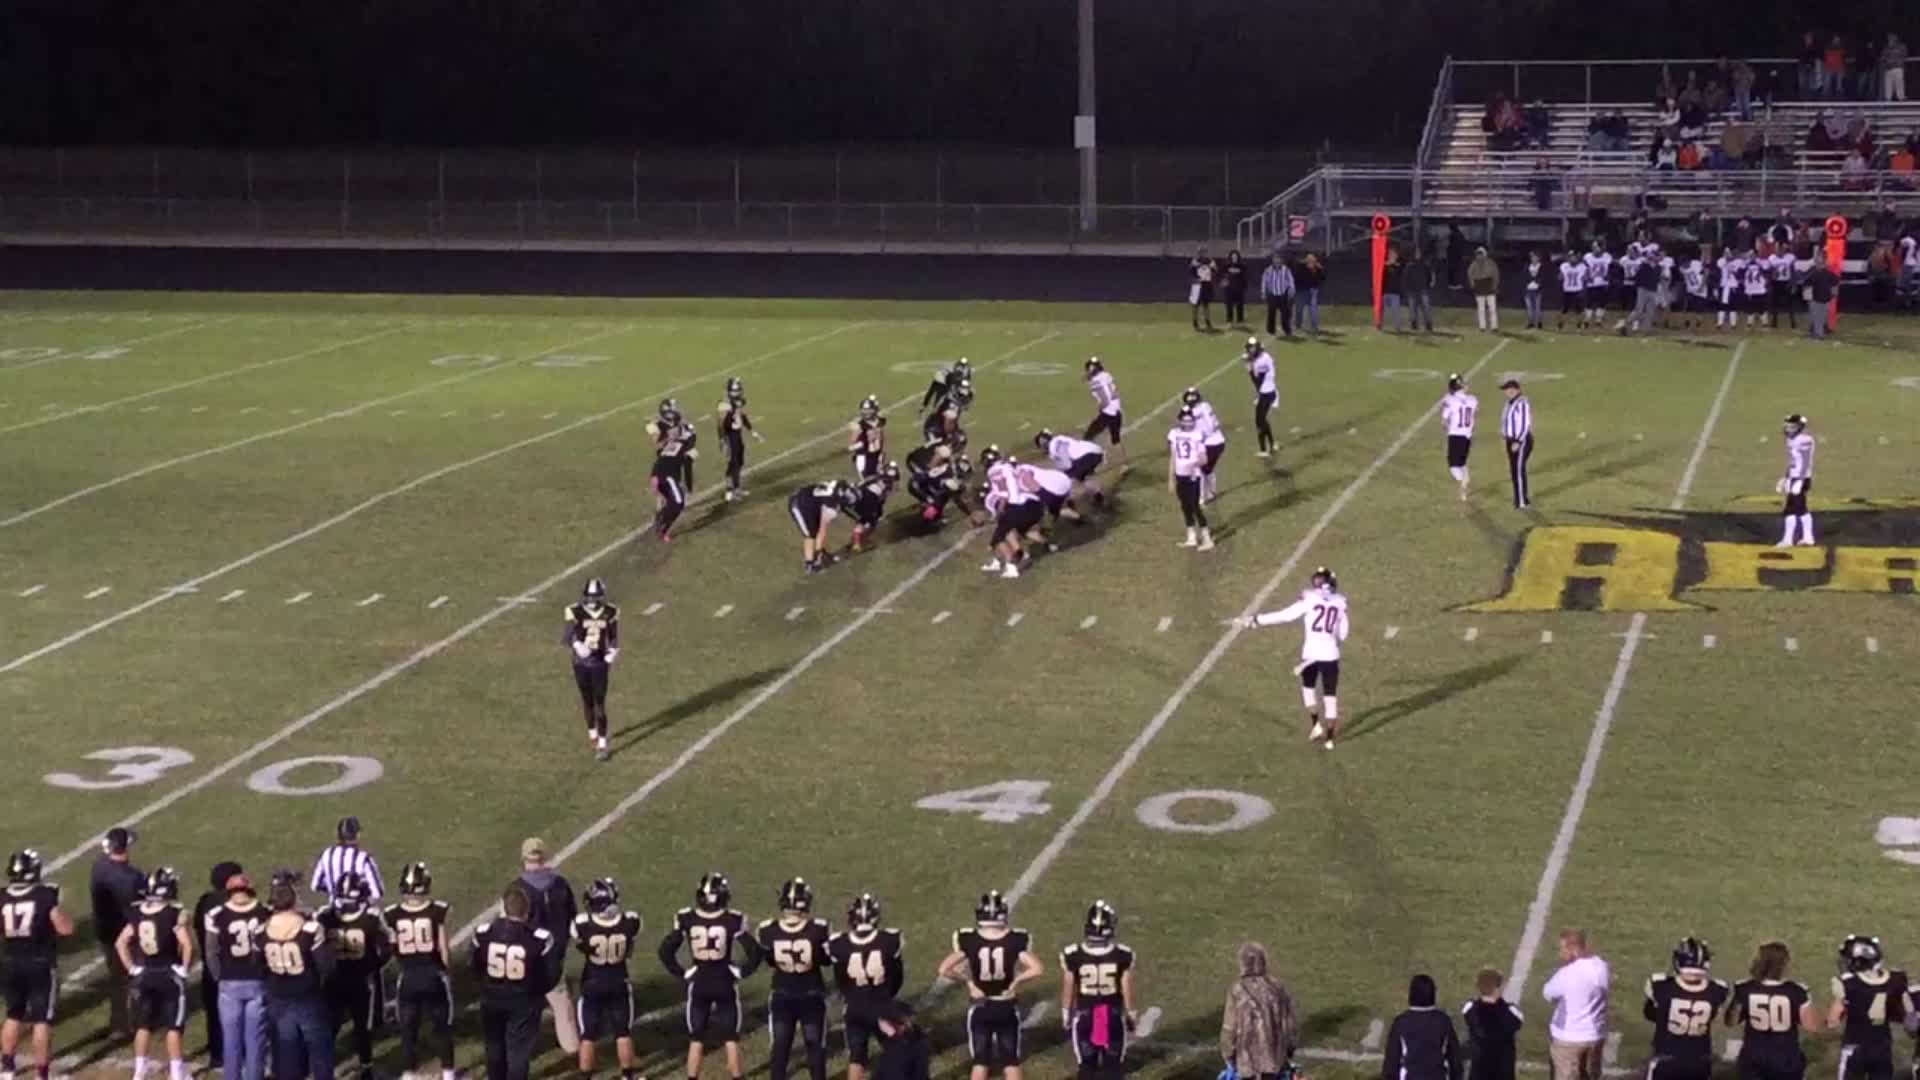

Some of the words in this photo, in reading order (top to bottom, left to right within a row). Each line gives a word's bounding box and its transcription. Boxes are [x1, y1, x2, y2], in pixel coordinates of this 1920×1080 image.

[1289, 219, 1305, 238] 2
[1457, 406, 1473, 428] 10
[1311, 603, 1339, 633] 20
[2, 901, 35, 937] 17
[397, 918, 433, 954] 20
[138, 920, 158, 955] 8
[589, 933, 626, 966] 30
[690, 925, 727, 960] 23
[487, 941, 526, 980] 56
[774, 939, 812, 973] 53
[847, 950, 885, 986] 44
[978, 946, 1005, 981] 11
[1079, 963, 1117, 996] 25
[1667, 998, 1712, 1036] 52
[1748, 993, 1791, 1032] 50
[1867, 992, 1887, 1025] 4
